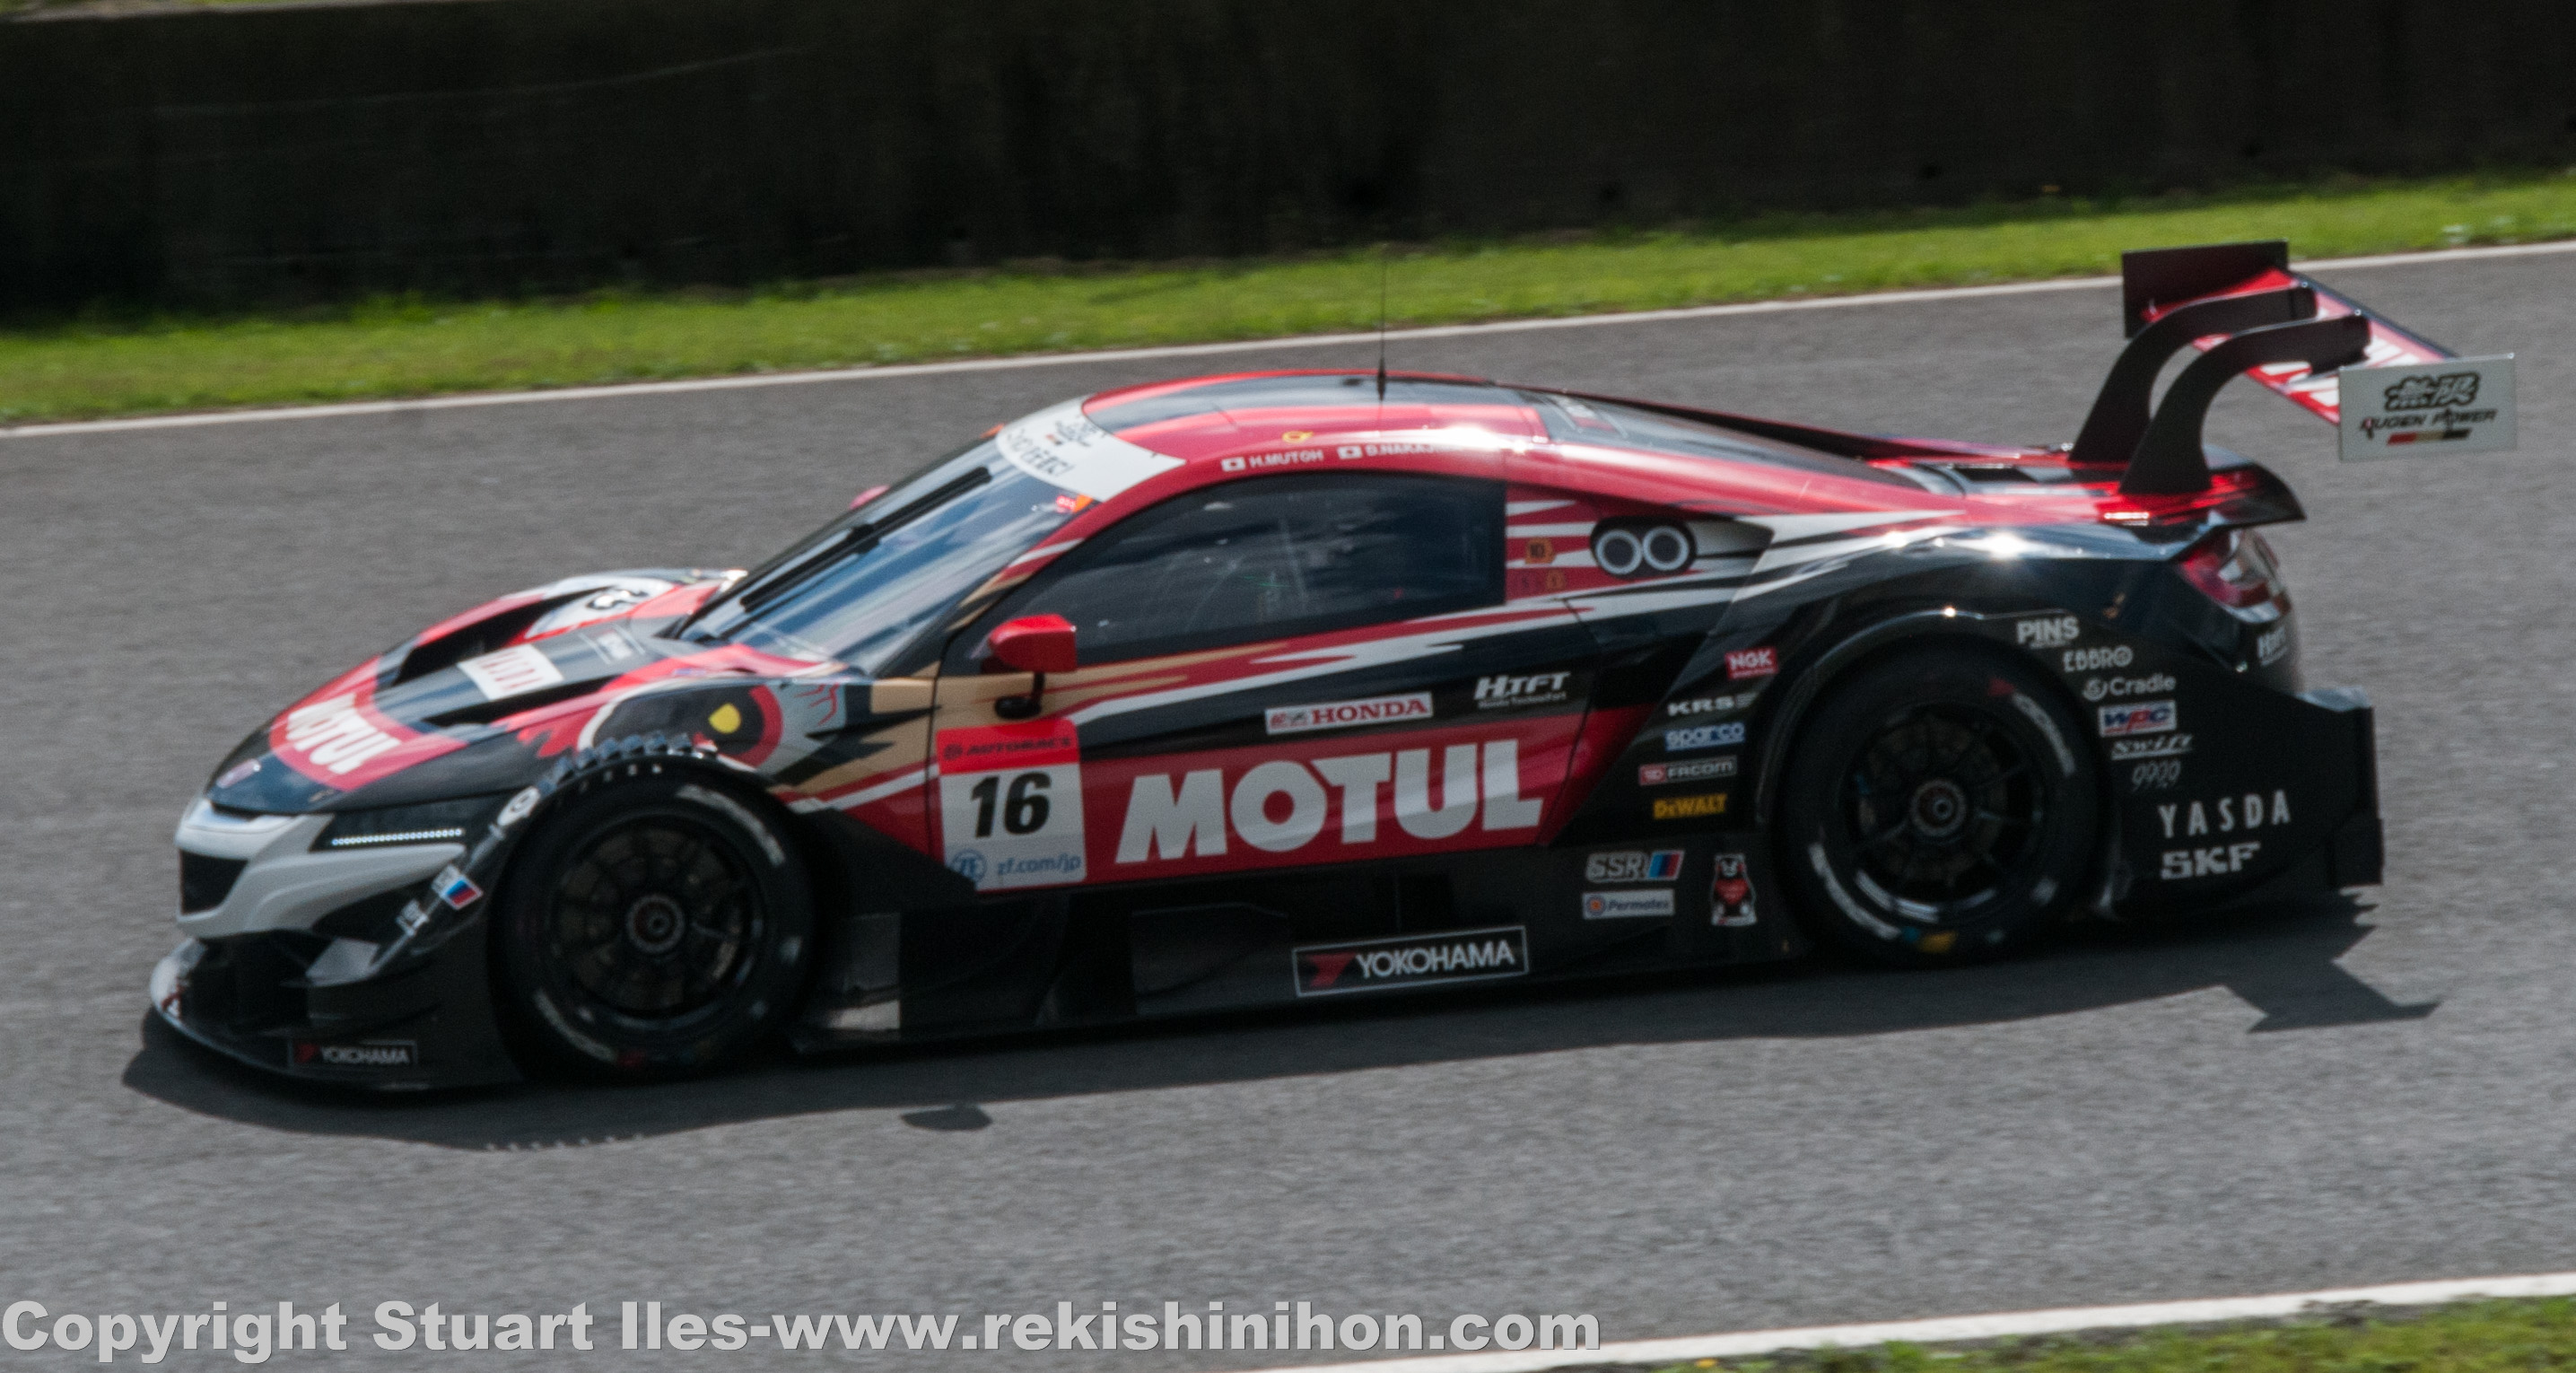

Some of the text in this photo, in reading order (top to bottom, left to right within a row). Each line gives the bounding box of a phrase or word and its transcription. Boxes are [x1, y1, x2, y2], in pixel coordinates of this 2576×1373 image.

[1249, 450, 1324, 469] H.MUTOH
[2017, 616, 2080, 644] PINS
[1728, 649, 1773, 670] NGK
[1474, 672, 1569, 700] HTFT
[2110, 673, 2176, 695] Cradle
[1312, 698, 1429, 724] HONDA
[1667, 695, 1733, 717] KRS
[285, 692, 401, 774] MOTUL
[971, 771, 1051, 839] 16
[1114, 739, 1543, 864] MOTUL
[2157, 790, 2290, 838] YASDA
[997, 853, 1082, 876] zf.com/jp
[2161, 842, 2261, 880] SKF
[1356, 940, 1515, 979] YOKOHAMA
[322, 1046, 411, 1064] YOKOHAMA
